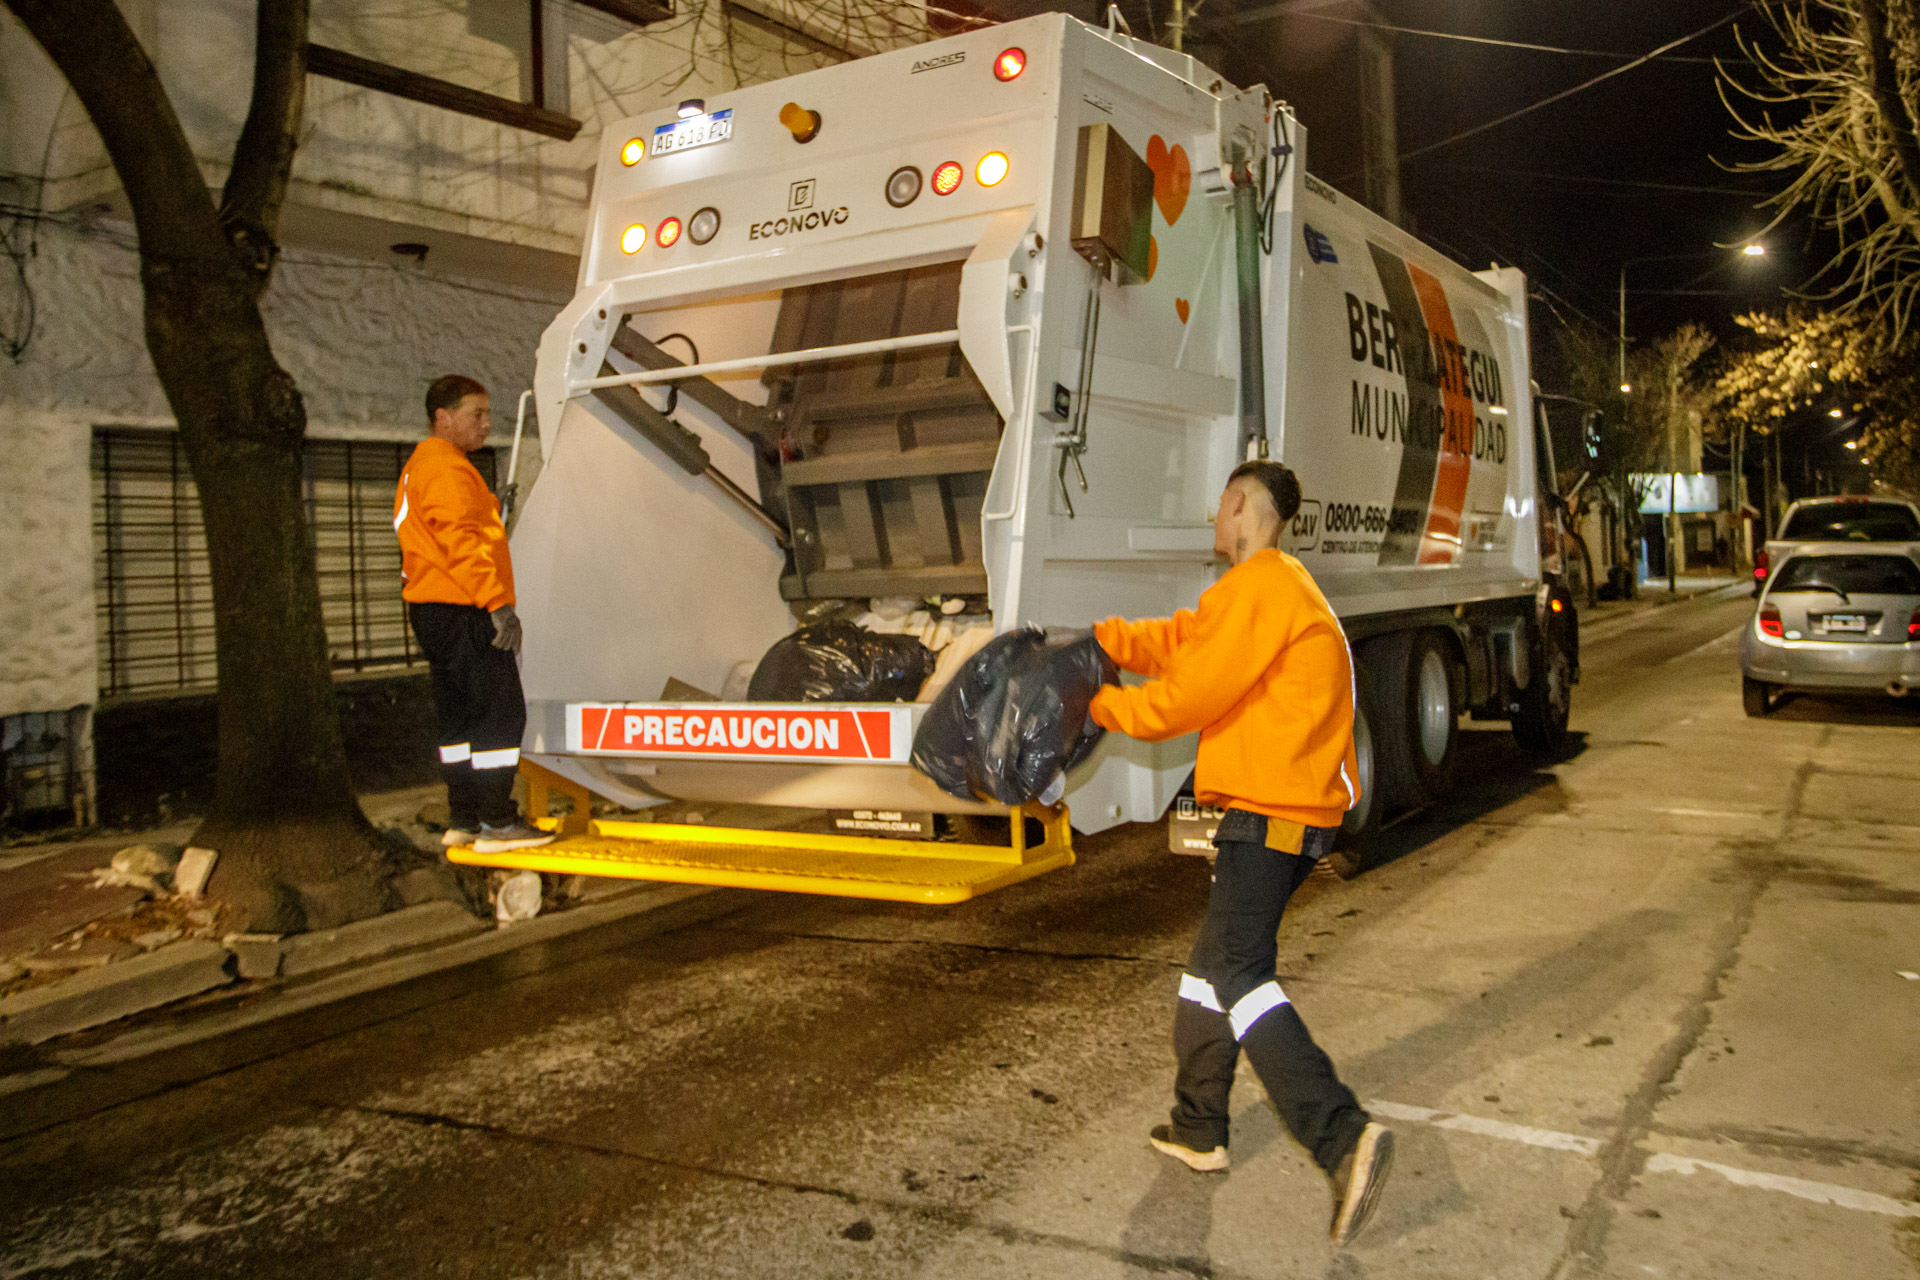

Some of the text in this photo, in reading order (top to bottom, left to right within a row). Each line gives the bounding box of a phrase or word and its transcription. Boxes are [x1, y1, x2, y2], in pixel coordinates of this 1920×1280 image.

[911, 51, 966, 73] ANDRES
[656, 133, 674, 153] AG
[749, 206, 849, 241] ECONOVO
[1292, 513, 1318, 537] CAV
[623, 715, 839, 750] PRECAUCION
